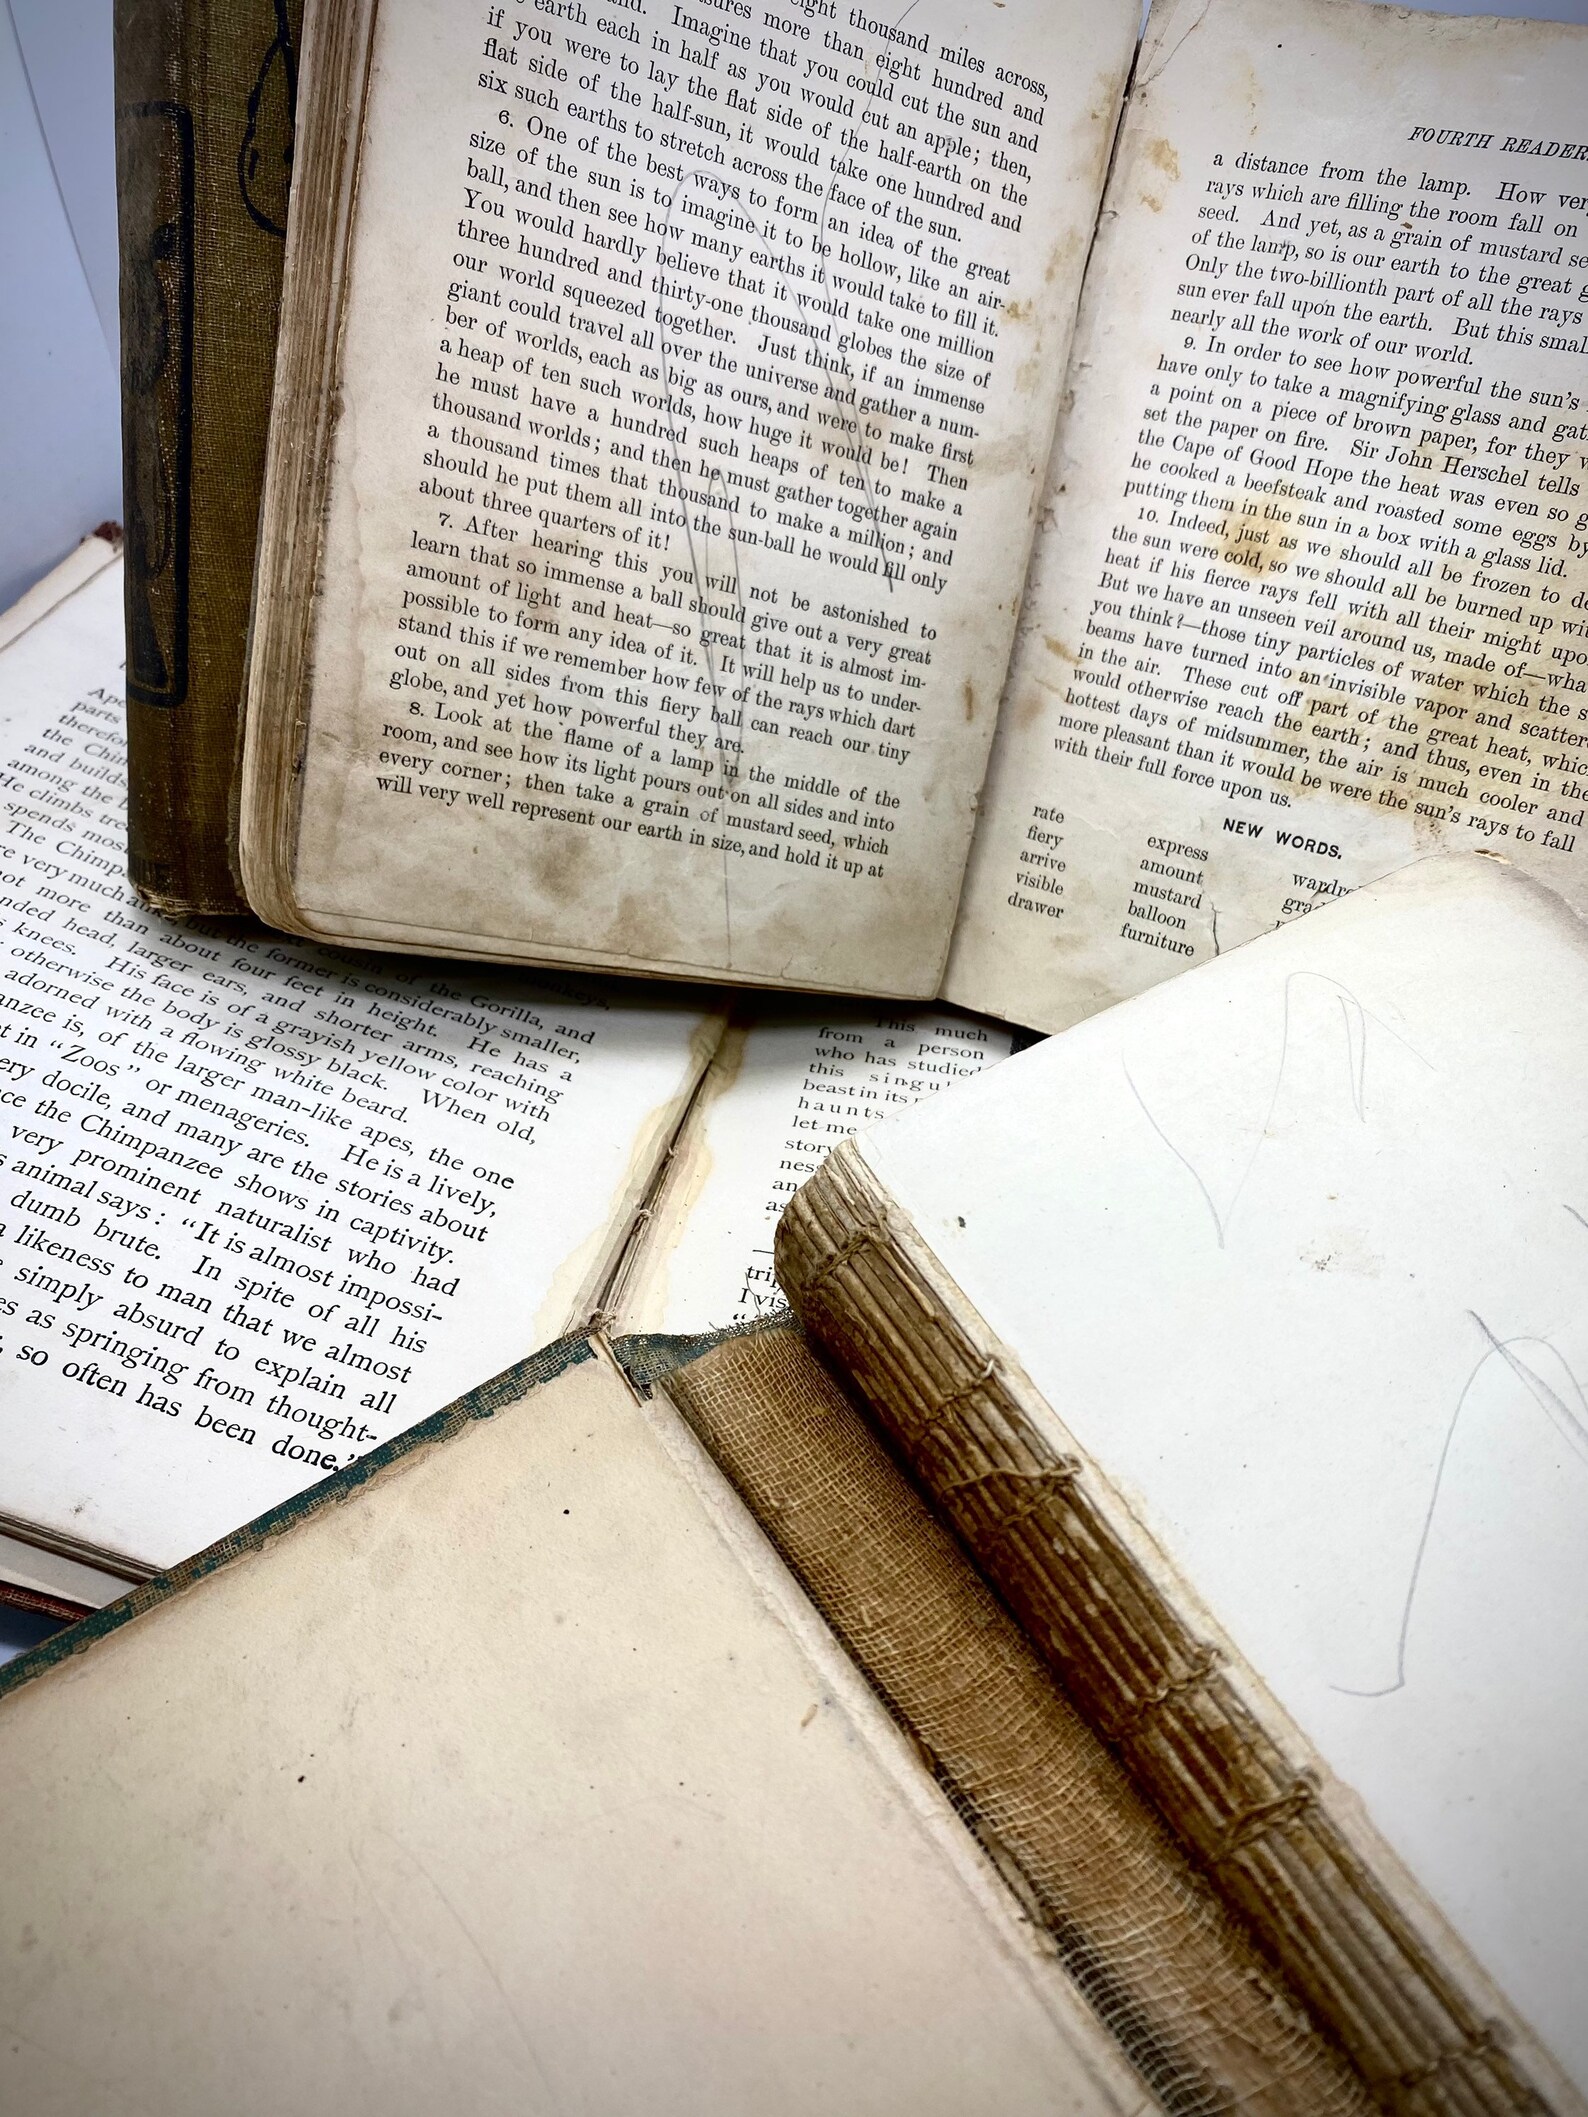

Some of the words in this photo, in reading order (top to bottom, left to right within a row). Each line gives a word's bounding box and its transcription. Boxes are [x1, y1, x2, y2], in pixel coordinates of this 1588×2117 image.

[848, 7, 929, 54] thousand
[938, 46, 985, 74] miles
[994, 66, 1048, 103] across,
[486, 5, 505, 29] if
[512, 20, 552, 46] you
[564, 37, 611, 65] were
[619, 52, 639, 75] to
[646, 59, 680, 93] lay
[687, 75, 718, 101] the
[724, 88, 757, 115] flat
[766, 104, 803, 130] side
[811, 121, 832, 140] of
[840, 128, 868, 153] the
[877, 138, 961, 185] half-earth
[970, 177, 990, 194] on
[1000, 183, 1028, 207] the
[1406, 125, 1495, 149] FOURTH
[1498, 136, 1588, 161] READER
[1212, 153, 1223, 166] a
[1234, 151, 1309, 176] distance
[1318, 160, 1364, 183] from
[1376, 167, 1407, 187] the
[1417, 171, 1471, 199] lamp.
[1494, 181, 1547, 205] How
[457, 218, 510, 250] three
[517, 234, 599, 276] hundred
[607, 267, 642, 289] and
[651, 275, 743, 317] thirty-one
[748, 304, 831, 343] thousand
[836, 331, 892, 360] globes
[900, 347, 927, 370] the
[934, 359, 965, 381] size
[972, 371, 991, 389] of
[1169, 308, 1226, 331] nearly
[1230, 313, 1255, 332] all
[1261, 317, 1290, 337] the
[1298, 326, 1344, 345] work
[1349, 331, 1371, 349] of
[1374, 339, 1408, 355] our
[1415, 344, 1473, 365] world.
[1142, 407, 1167, 422] set
[1175, 409, 1202, 429] the
[1207, 419, 1259, 440] paper
[1264, 429, 1286, 444] on
[1293, 429, 1328, 451] fire.
[1349, 438, 1379, 459] Sir
[1384, 445, 1432, 470] John
[1439, 455, 1529, 487] Herschel
[1537, 474, 1580, 497] tells
[418, 476, 474, 504] about
[482, 490, 532, 518] three
[538, 509, 616, 538] quarters
[621, 526, 643, 544] of
[646, 529, 670, 551] it!
[69, 700, 123, 725] parts
[388, 667, 447, 698] globe,
[453, 683, 489, 702] and
[493, 691, 526, 710] yet
[532, 693, 573, 718] how
[579, 708, 660, 737] powerful
[668, 723, 708, 750] they
[713, 728, 744, 758] are.
[23, 743, 65, 764] and
[41, 727, 74, 747] the
[6, 758, 79, 793] among
[81, 782, 114, 804] the
[1054, 736, 1088, 757] with
[1094, 745, 1133, 768] their
[1136, 755, 1167, 777] full
[1170, 763, 1214, 788] force
[1220, 779, 1262, 801] upon
[1269, 791, 1291, 808] us.
[3, 800, 77, 834] spends
[28, 782, 95, 819] climbs
[1032, 805, 1064, 824] rate
[5, 819, 46, 845] The
[375, 774, 412, 795] will
[418, 784, 461, 806] very
[466, 791, 504, 810] well
[510, 800, 596, 826] represent
[601, 816, 632, 832] our
[637, 823, 682, 842] earth
[688, 828, 705, 846] in
[710, 833, 745, 857] size,
[748, 843, 780, 860] and
[784, 845, 821, 867] hold
[824, 853, 838, 870] it
[843, 860, 863, 878] up
[867, 863, 884, 878] at
[1026, 824, 1064, 851] fiery
[1222, 817, 1264, 839] NEW
[1276, 830, 1342, 860] WORDS.
[1019, 850, 1066, 872] arrive
[1146, 836, 1209, 862] express
[21, 853, 67, 880] very
[67, 870, 130, 903] much
[1016, 870, 1064, 895] visible
[1139, 859, 1204, 885] amount
[1007, 891, 1064, 919] drawer
[1132, 881, 1202, 910] mustard
[1127, 899, 1186, 930] balloon
[1119, 922, 1194, 957] furniture
[3, 970, 100, 1009] adorned
[106, 1006, 152, 1030] with
[159, 1027, 174, 1038] a
[179, 1031, 266, 1074] flowing
[274, 1067, 333, 1095] white
[341, 1087, 407, 1123] beard.
[817, 1025, 863, 1044] from
[883, 1038, 896, 1049] a
[916, 1043, 984, 1061] person
[934, 1024, 989, 1043] much
[808, 1061, 844, 1077] this
[814, 1045, 855, 1061] who
[863, 1050, 896, 1067] has
[797, 1095, 884, 1120] haunts
[802, 1077, 856, 1096] beast
[858, 1085, 877, 1100] in
[884, 1089, 908, 1104] its
[13, 1026, 38, 1049] in
[145, 1079, 173, 1095] or
[174, 1089, 309, 1147] menageries.
[340, 1143, 379, 1171] He
[382, 1158, 403, 1180] is
[406, 1173, 421, 1187] a
[427, 1175, 495, 1218] lively,
[791, 1114, 819, 1130] let
[825, 1123, 857, 1136] me
[34, 1099, 71, 1123] the
[80, 1114, 223, 1179] Chimpanzee
[233, 1173, 309, 1210] shows
[314, 1199, 340, 1223] in
[349, 1217, 453, 1264] captivity.
[10, 1190, 81, 1227] dumb
[92, 1217, 160, 1260] brute.
[191, 1254, 222, 1281] In
[233, 1276, 295, 1308] spite
[307, 1304, 341, 1323] of
[343, 1314, 380, 1338] all
[388, 1325, 427, 1353] his
[13, 1267, 104, 1311] simply
[112, 1301, 205, 1346] absurd
[214, 1338, 240, 1361] to
[254, 1357, 346, 1400] explain
[359, 1390, 397, 1414] all
[15, 1345, 49, 1366] so
[61, 1362, 127, 1397] often
[134, 1382, 182, 1417] has
[193, 1404, 256, 1445] been
